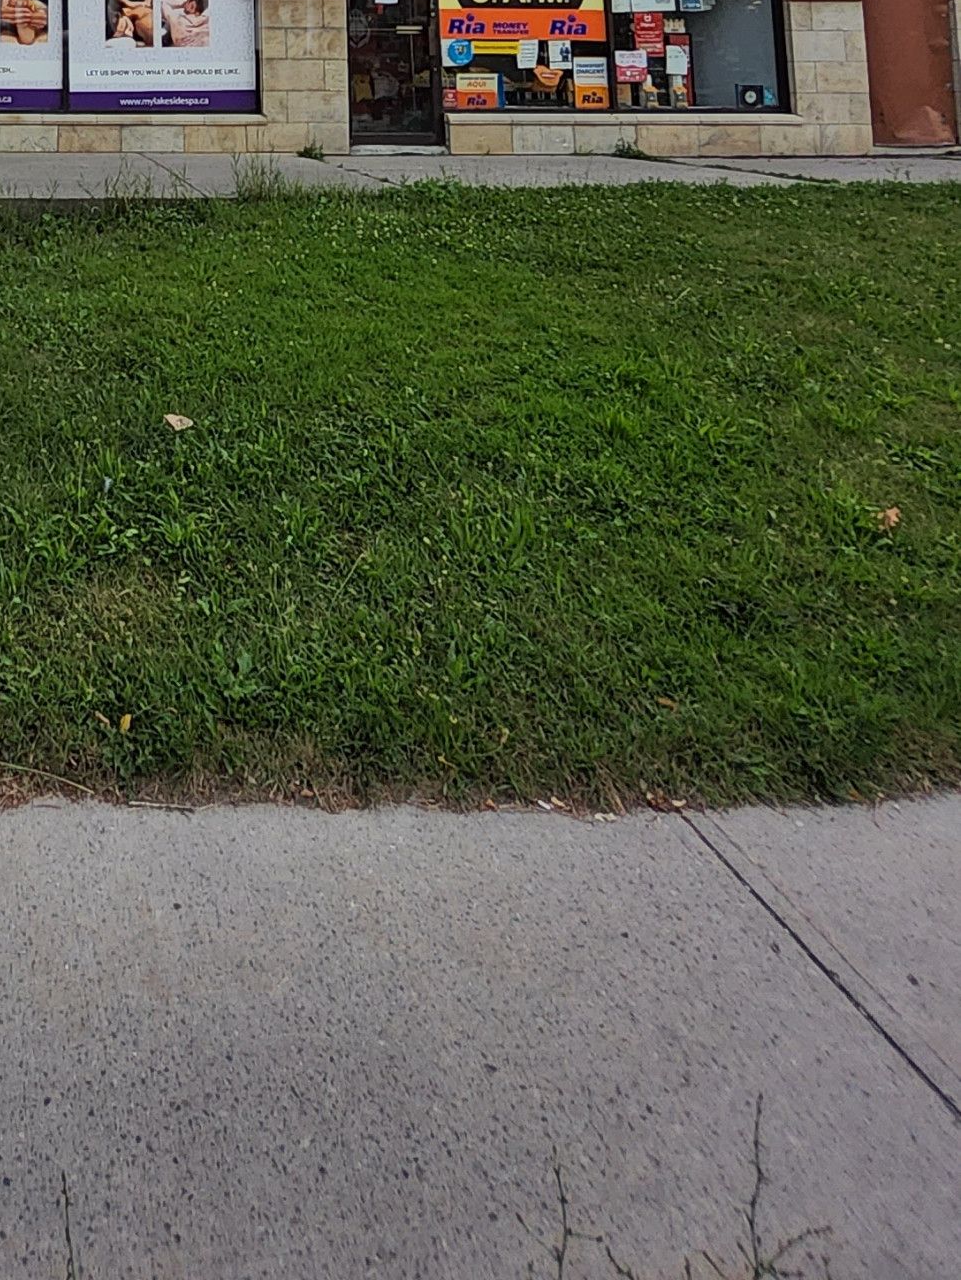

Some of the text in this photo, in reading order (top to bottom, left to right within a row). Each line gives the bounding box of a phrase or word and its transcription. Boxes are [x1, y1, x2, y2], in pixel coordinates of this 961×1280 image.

[448, 13, 486, 35] Ria
[549, 14, 587, 35] Ria
[119, 96, 210, 107] www.mylakesidespa.ca
[466, 94, 488, 107] Ria
[582, 91, 605, 104] Ria
